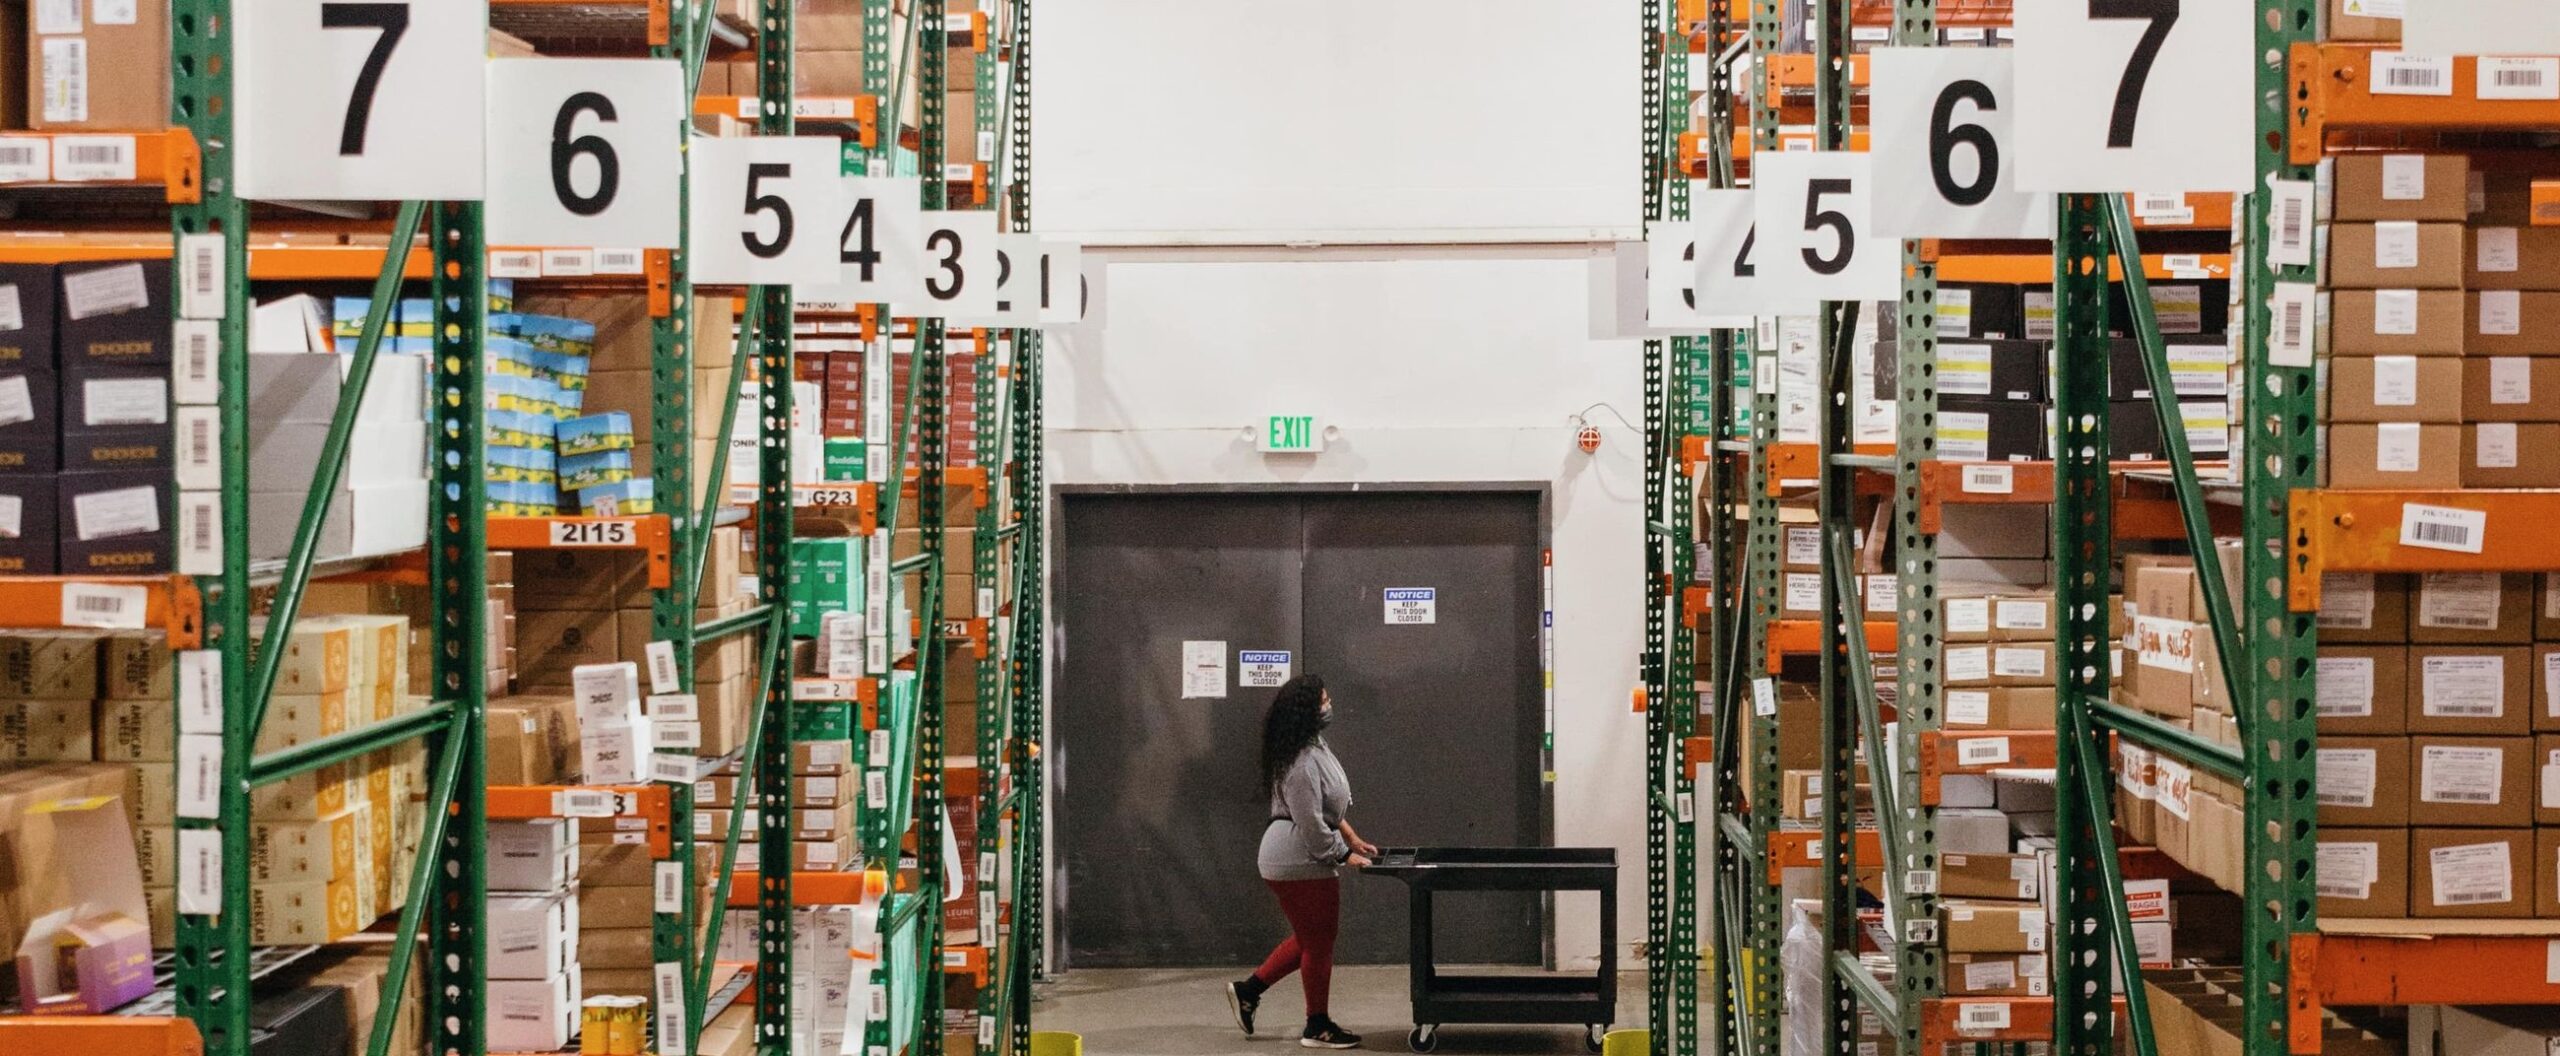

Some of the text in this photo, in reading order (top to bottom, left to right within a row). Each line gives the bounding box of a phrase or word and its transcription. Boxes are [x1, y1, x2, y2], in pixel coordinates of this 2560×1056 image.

[321, 3, 410, 156] 7
[2088, 0, 2179, 148] 7
[551, 91, 619, 216] 6
[1930, 79, 1998, 206] 6
[741, 163, 793, 258] 5
[1801, 178, 1854, 275] 5
[840, 199, 880, 282] 4
[925, 229, 964, 300] 3
[1269, 416, 1313, 448] EXIT
[812, 490, 852, 505] G23
[1389, 591, 1431, 599] NOTICE
[945, 624, 962, 635] 21
[1245, 654, 1288, 662] NOTICE
[2025, 885, 2031, 894] 6
[2129, 900, 2160, 910] FRAGILE
[2033, 938, 2040, 947] 6
[2034, 982, 2040, 992] 6
